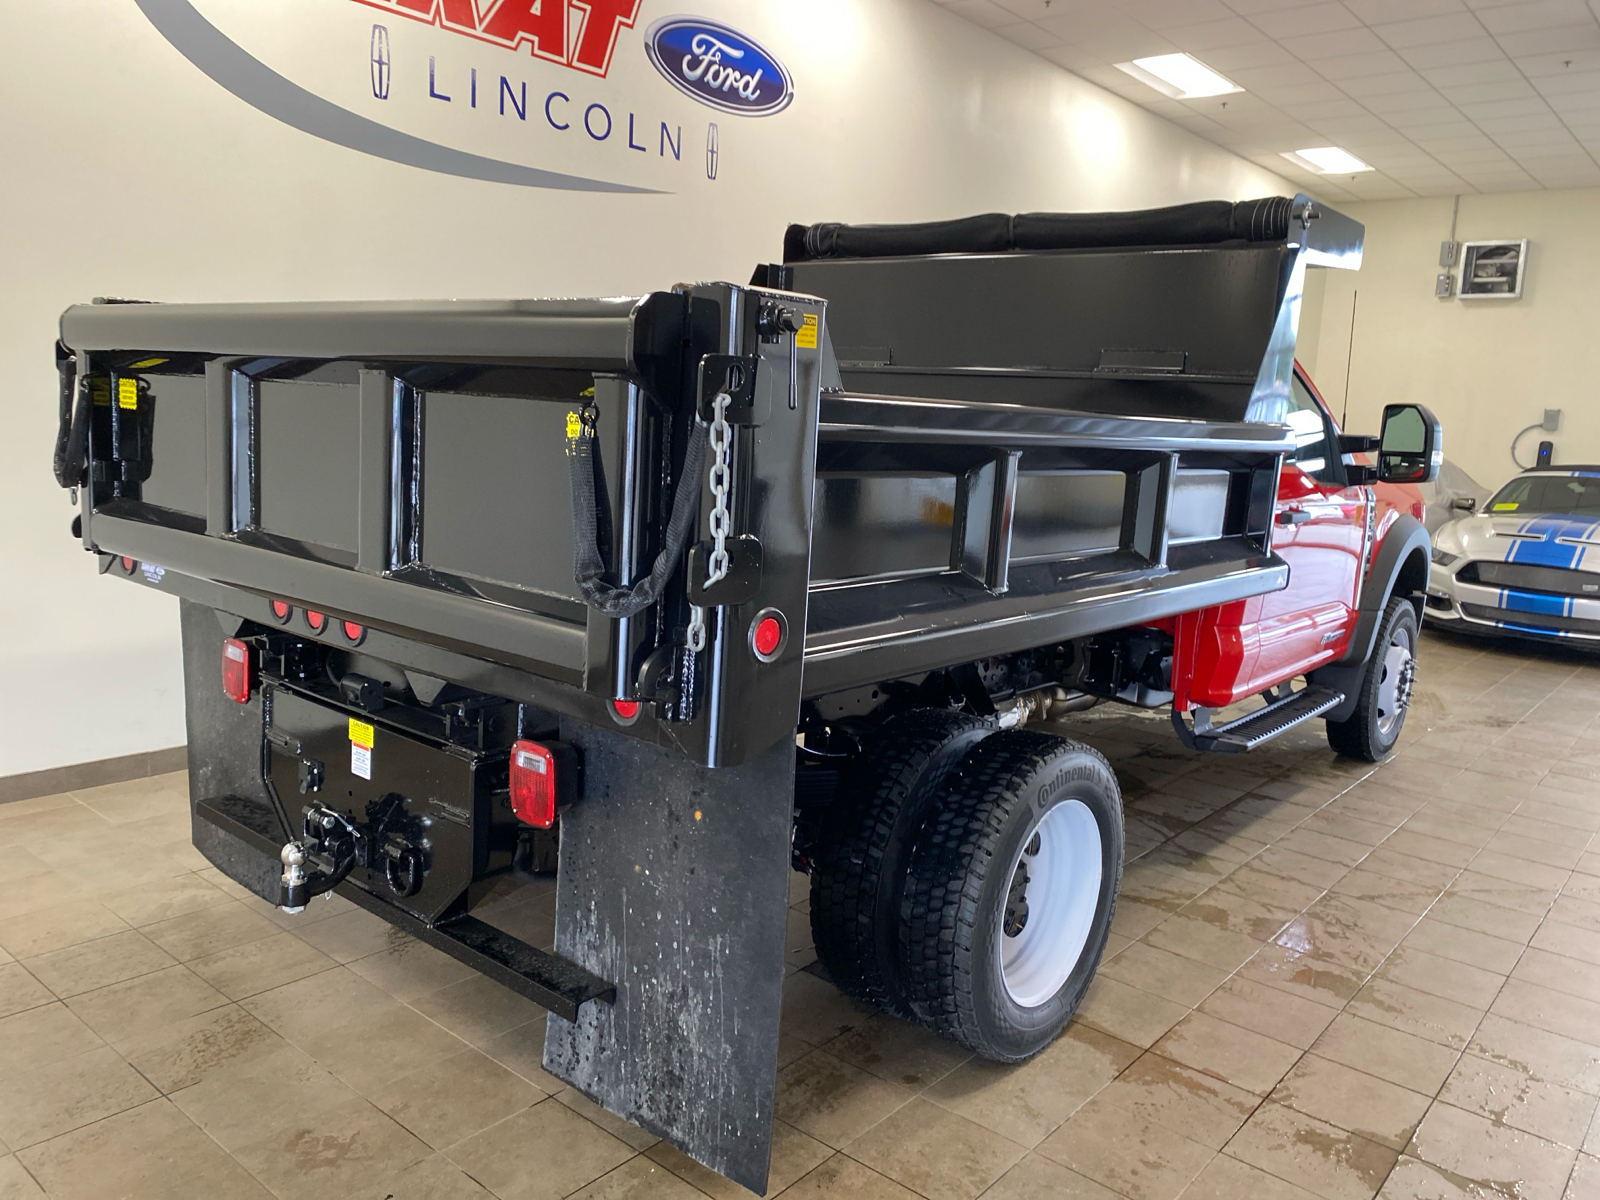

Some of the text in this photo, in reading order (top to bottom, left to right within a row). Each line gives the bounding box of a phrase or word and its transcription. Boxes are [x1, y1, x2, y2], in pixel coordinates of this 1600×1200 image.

[681, 33, 764, 101] Ford
[428, 55, 683, 161] LINCOLN
[352, 720, 370, 731] CAUTION
[1037, 764, 1096, 809] Continental
